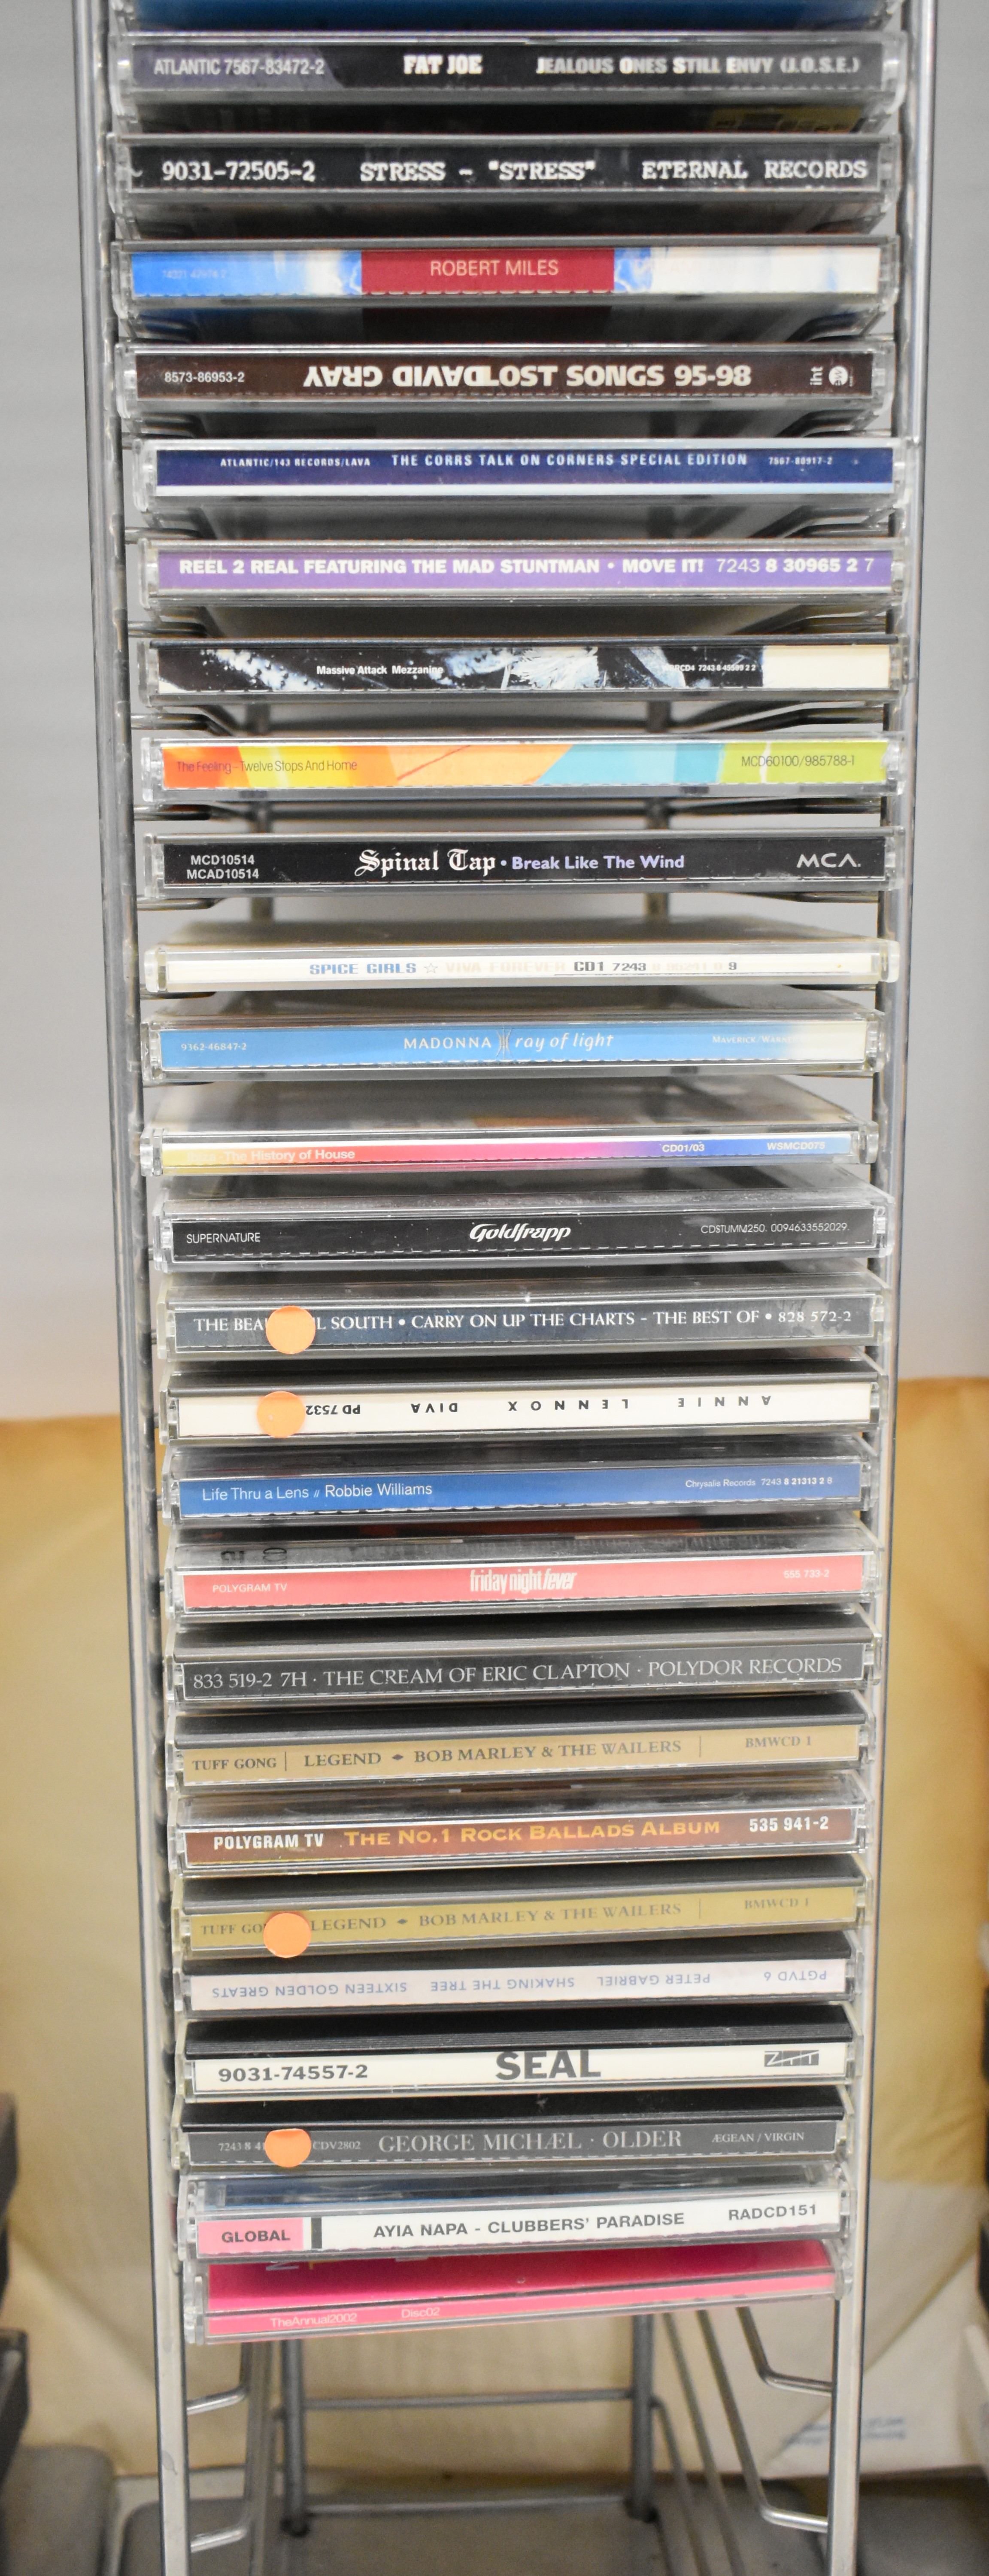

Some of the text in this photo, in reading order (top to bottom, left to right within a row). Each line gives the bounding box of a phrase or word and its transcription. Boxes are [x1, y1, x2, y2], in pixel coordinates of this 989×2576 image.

[154, 55, 859, 75] ATLANTIC 7567-83472-2 FAT JOE JEALOUS ONES STILL ENVY (J.O.S.E.)
[162, 160, 868, 182] 9031-72505-2 STRESS "STRESS" ETERNAL RECORDS
[431, 259, 559, 276] ROBERT MILES
[164, 371, 245, 383] 8573-86953-2
[303, 365, 490, 387] DAVID GRAY
[566, 365, 664, 386] SONGS
[674, 365, 752, 386] 95-98
[220, 454, 832, 467] ATLANTIC/143 RECORDS/LAVA CORRS TALK CORNERS SPECIAL EDITION 7567-80917-2
[180, 558, 840, 574] REEL 2 REAL FEATURING MAD STUNTMAN MOVE IT! 7243 30965
[316, 665, 355, 675] Massive
[357, 665, 387, 675] Attack
[391, 665, 443, 676] Mezzanine
[196, 755, 854, 774] Feeling Twelve Stops Home MCD60100/985788-1
[191, 854, 255, 866] MCD10514
[354, 848, 685, 878] Spinal Tap Break Like Wind
[186, 868, 259, 879] MCAD10514
[309, 961, 646, 975] SPICE GIRLS VIVA FOREVER CD1 7243
[181, 1033, 614, 1051] 9362-46847-2 MADONNA ray light
[251, 1141, 825, 1162] History House CD01/03 WSMCD075
[186, 1232, 261, 1244] SUPERNATURE
[469, 1223, 571, 1242] Goldfrapp
[193, 1318, 229, 1331] THE
[331, 1316, 392, 1330] SOUTH
[411, 1315, 464, 1328] CARRY
[570, 1312, 635, 1326] CHARTS
[693, 1310, 732, 1324] BEST
[778, 1311, 804, 1322] 828
[810, 1310, 851, 1323] 572-2
[342, 1396, 771, 1415] ANNIE LENNOX DIVA PD
[203, 1488, 228, 1501] Life
[231, 1487, 261, 1500] Thru
[276, 1487, 309, 1499] Lens
[325, 1485, 372, 1498] Robbie
[377, 1483, 432, 1496] Williams
[685, 1480, 721, 1489] Chrysalis
[212, 1568, 829, 1595] POLYGRAM friday night fever 555 733-2
[193, 1657, 842, 1689] 833 519-2 CREAM ERIC CLAPTON POLYDOR RECORDS
[193, 1736, 801, 1770] TUFF GONG LEGEND BOB MARLEY WAILERS BMWCD
[214, 1816, 828, 1850] POLYGRAM TV ROCK BALLADS ALBUM 535 941-2
[310, 1904, 681, 1931] LEGEND BOB MARLEY WAILERS
[212, 1970, 827, 1998] PGTVD PETER GABRIEL SHAKING TREE SIXTEEN GOLDEN GREATS
[218, 2064, 367, 2082] 9031-74557-2
[495, 2049, 601, 2081] SEAL
[312, 2141, 361, 2150] CDV2802
[379, 2134, 474, 2152] GEORGE
[603, 2130, 681, 2148] OLDER
[764, 2132, 804, 2142] VIRGIN
[221, 2230, 291, 2243] GLOBAL
[373, 2225, 414, 2238] AYIA
[421, 2223, 468, 2236] NAPA
[597, 2212, 684, 2229] PARADISE
[728, 2204, 816, 2221] RADCD151
[271, 2307, 440, 2327] TheAnnual2002 Disc02
